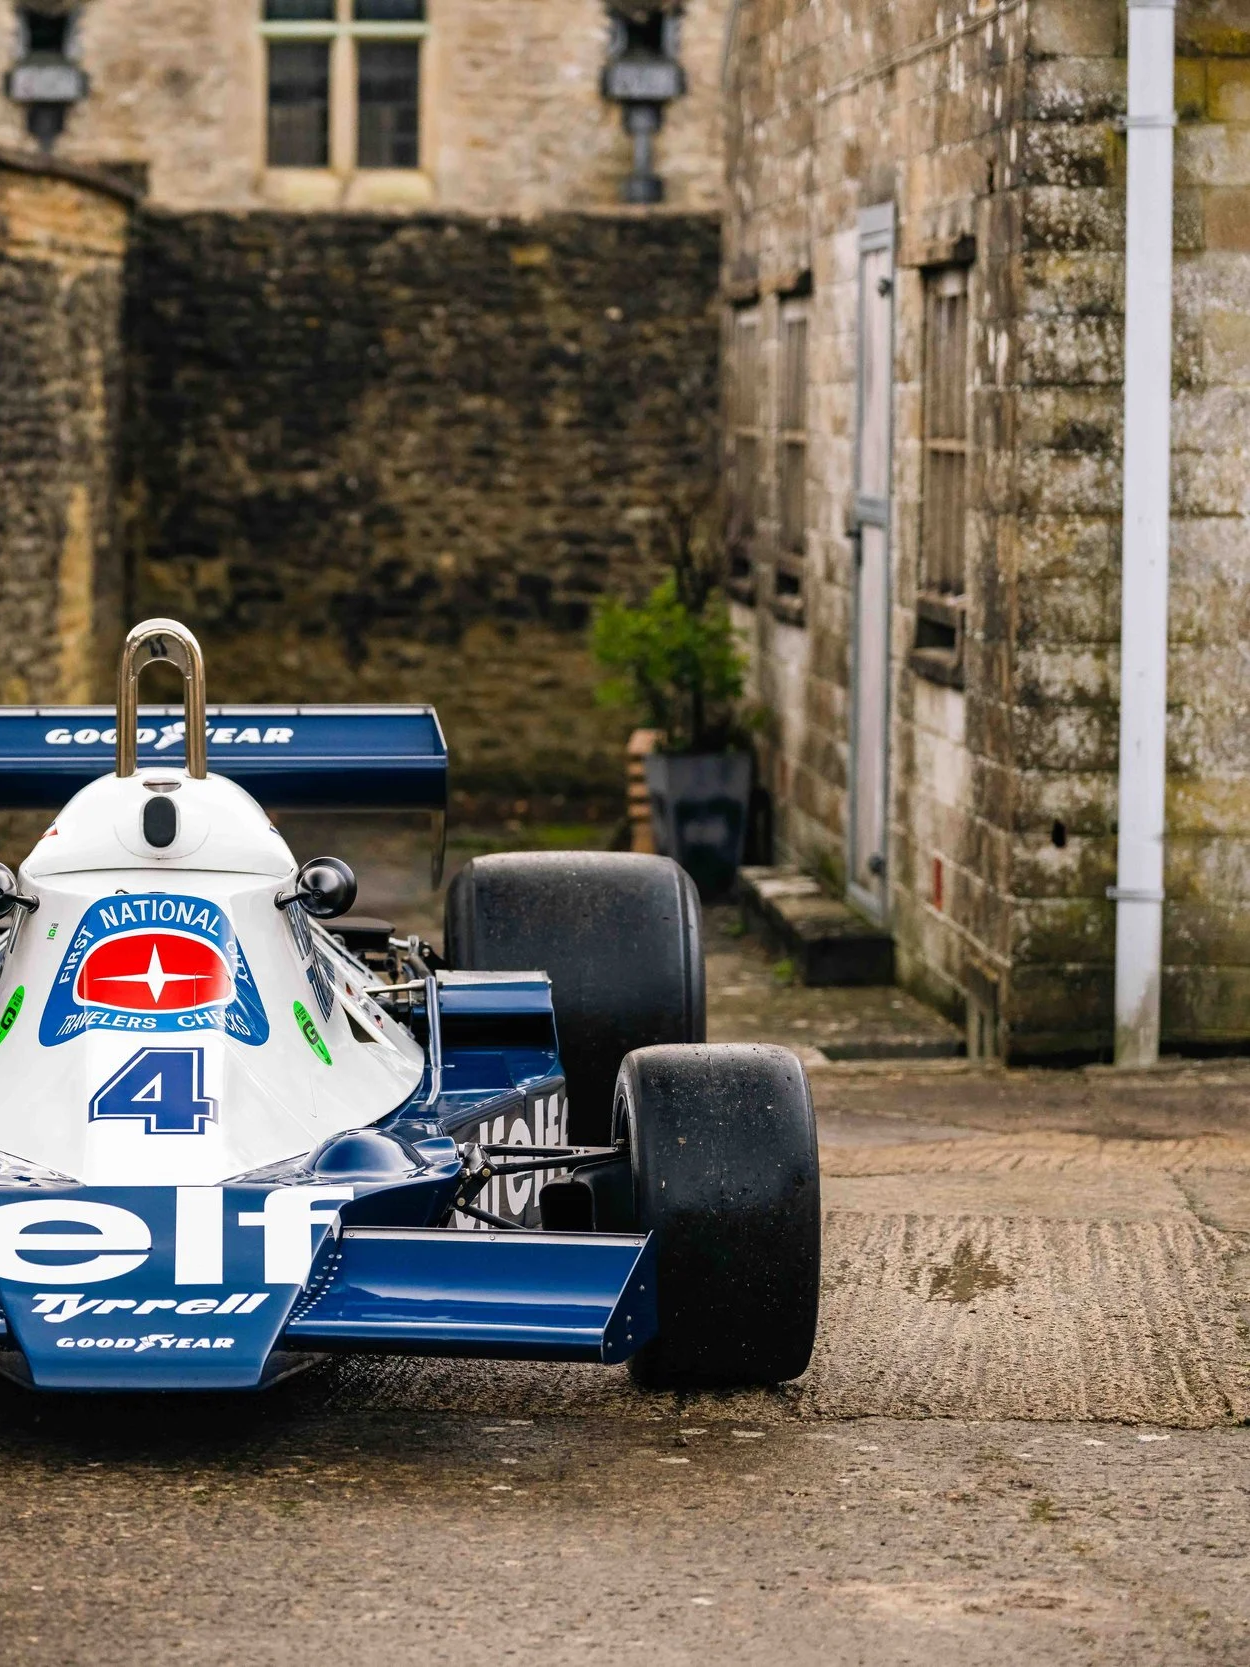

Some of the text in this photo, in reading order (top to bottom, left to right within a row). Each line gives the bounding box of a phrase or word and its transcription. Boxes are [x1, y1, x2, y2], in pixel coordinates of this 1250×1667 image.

[58, 899, 252, 988] FIRST NATIONAL CITY
[0, 1006, 17, 1031] G
[55, 1008, 251, 1037] TRAVELERS CHECKS
[302, 1020, 320, 1046] G
[88, 1047, 219, 1135] 4
[31, 1293, 270, 1323] Tyrrell
[56, 1333, 235, 1353] GOODYEAR
